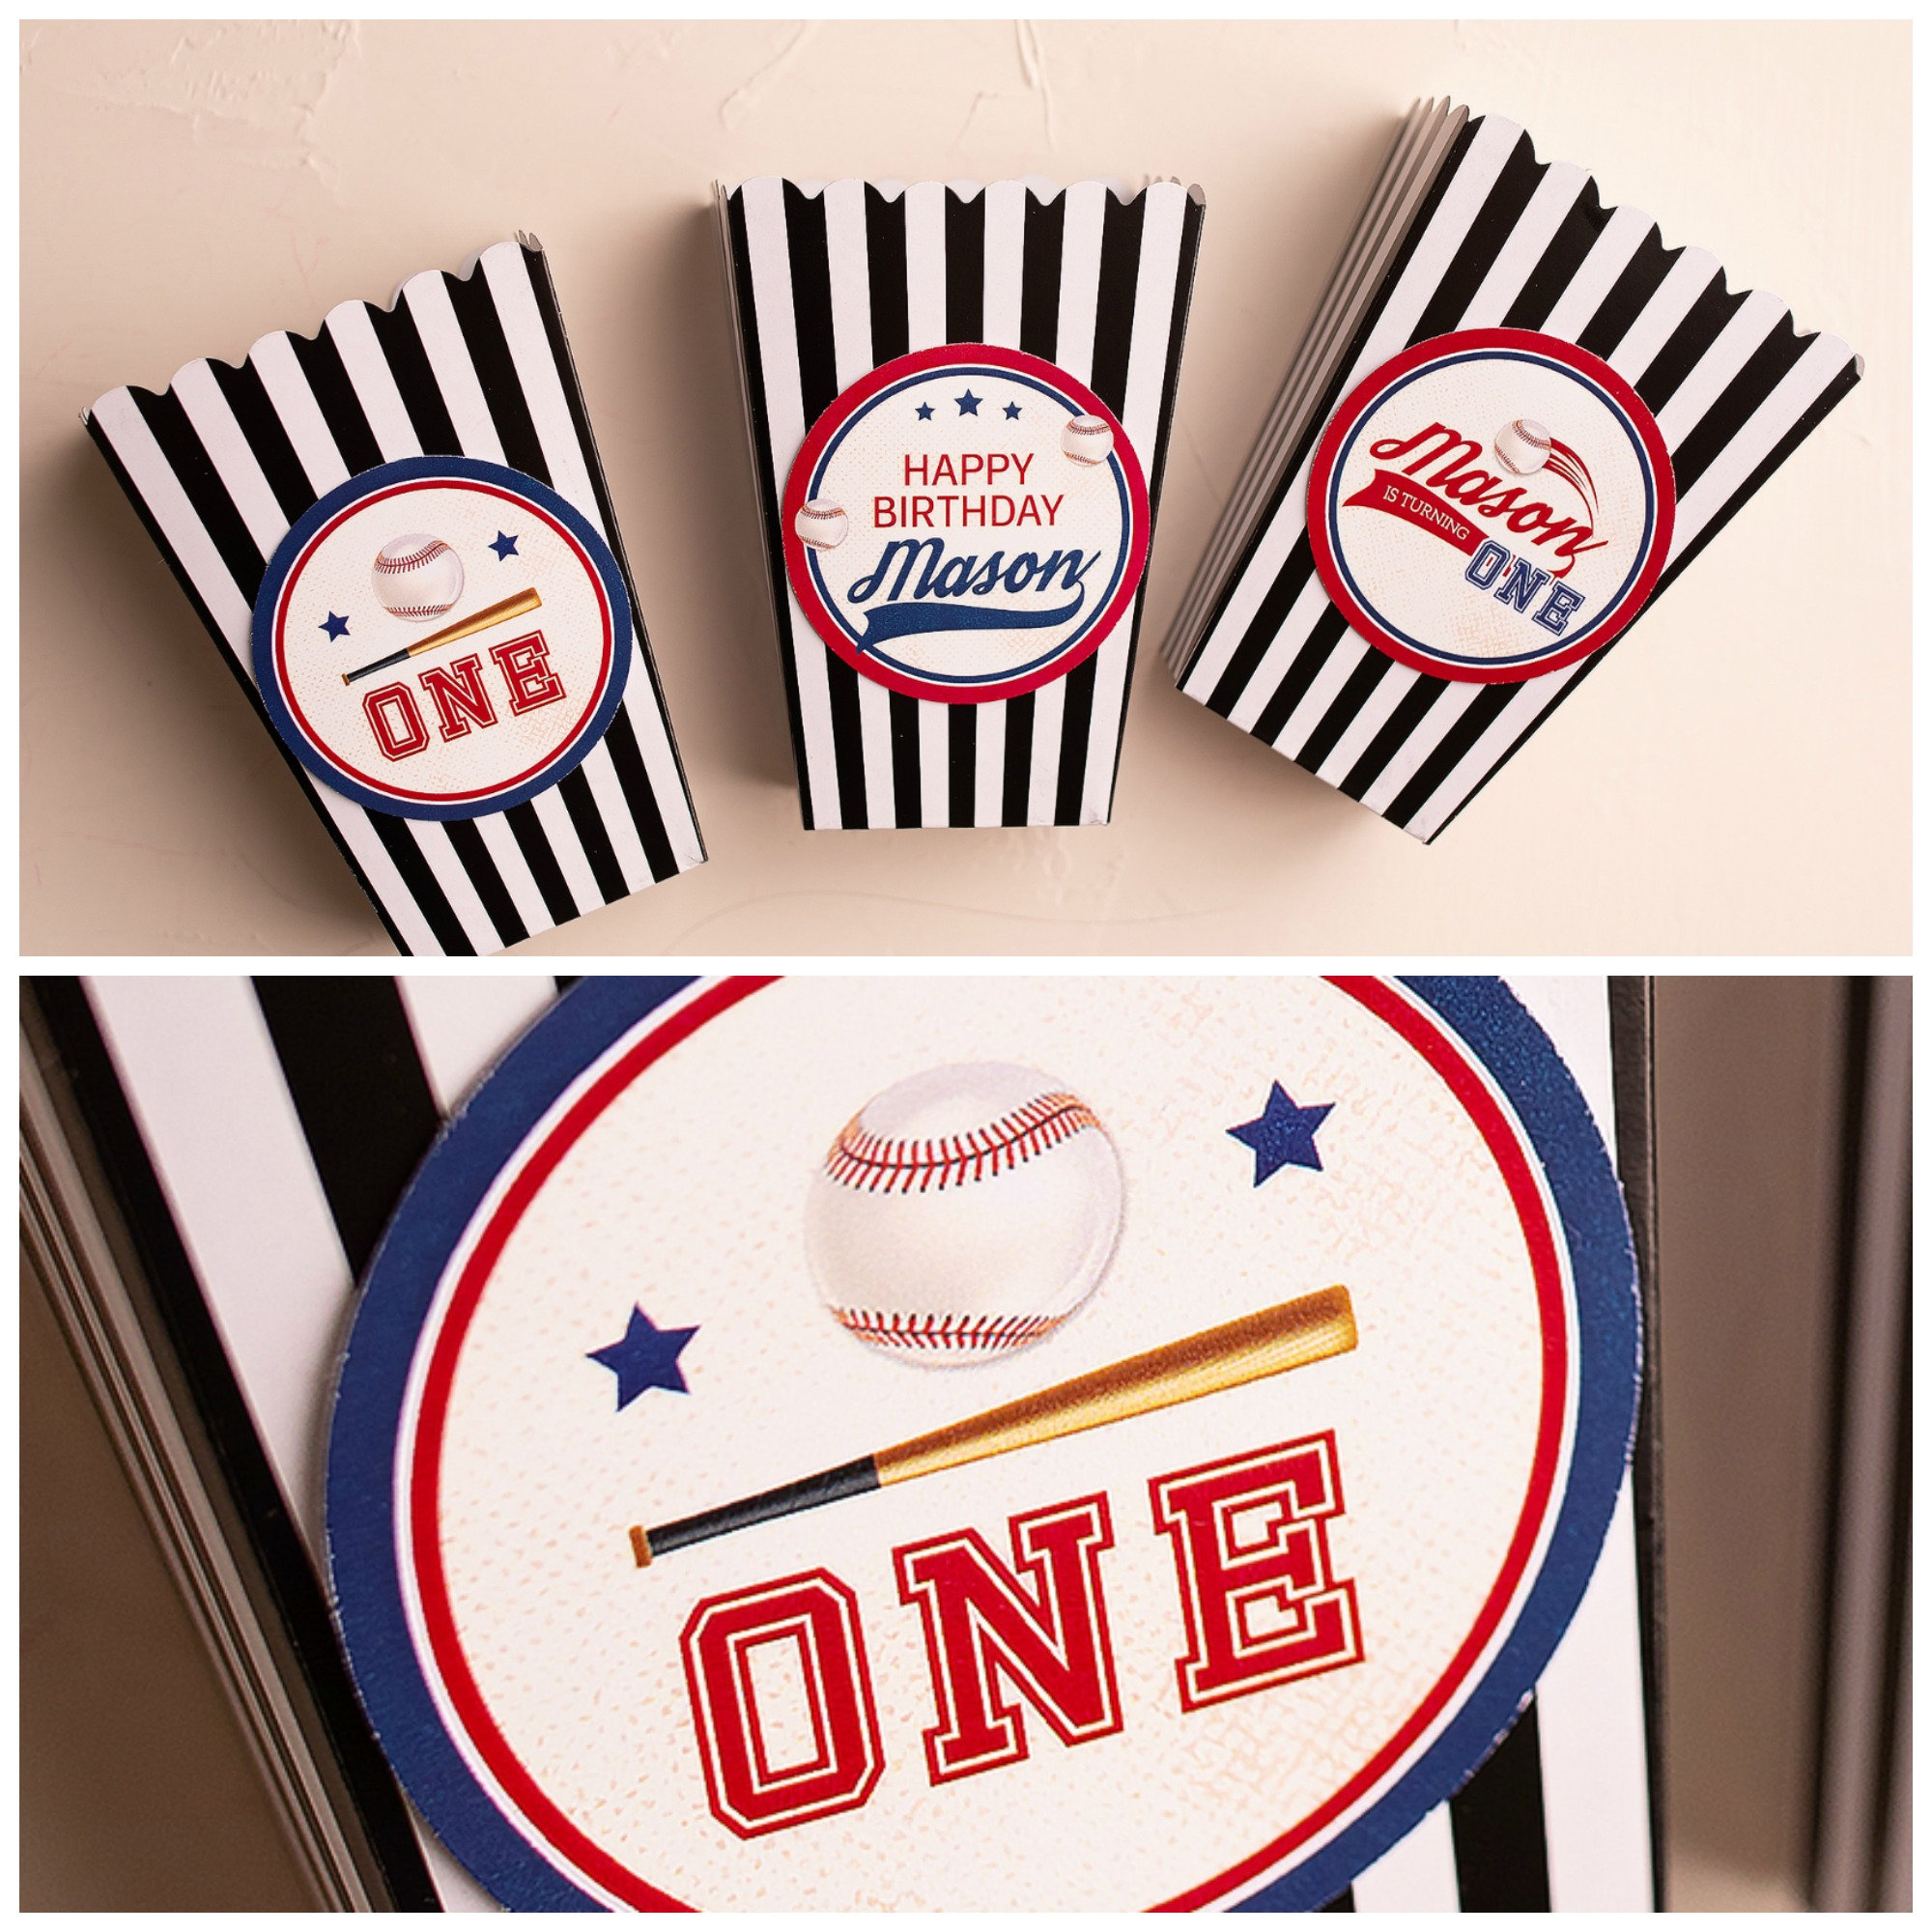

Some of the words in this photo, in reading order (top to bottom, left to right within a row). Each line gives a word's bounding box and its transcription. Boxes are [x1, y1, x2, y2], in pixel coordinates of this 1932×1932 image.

[903, 452, 1035, 486] HAPPY
[1369, 421, 1609, 558] Mason
[873, 494, 1065, 528] BIRTHDAY
[1382, 484, 1397, 501] IS
[1400, 491, 1470, 541] TURNING
[847, 537, 1101, 604] Mason
[1464, 539, 1586, 637] ONE
[361, 629, 567, 762] ONE
[679, 1429, 1366, 1840] ONE
